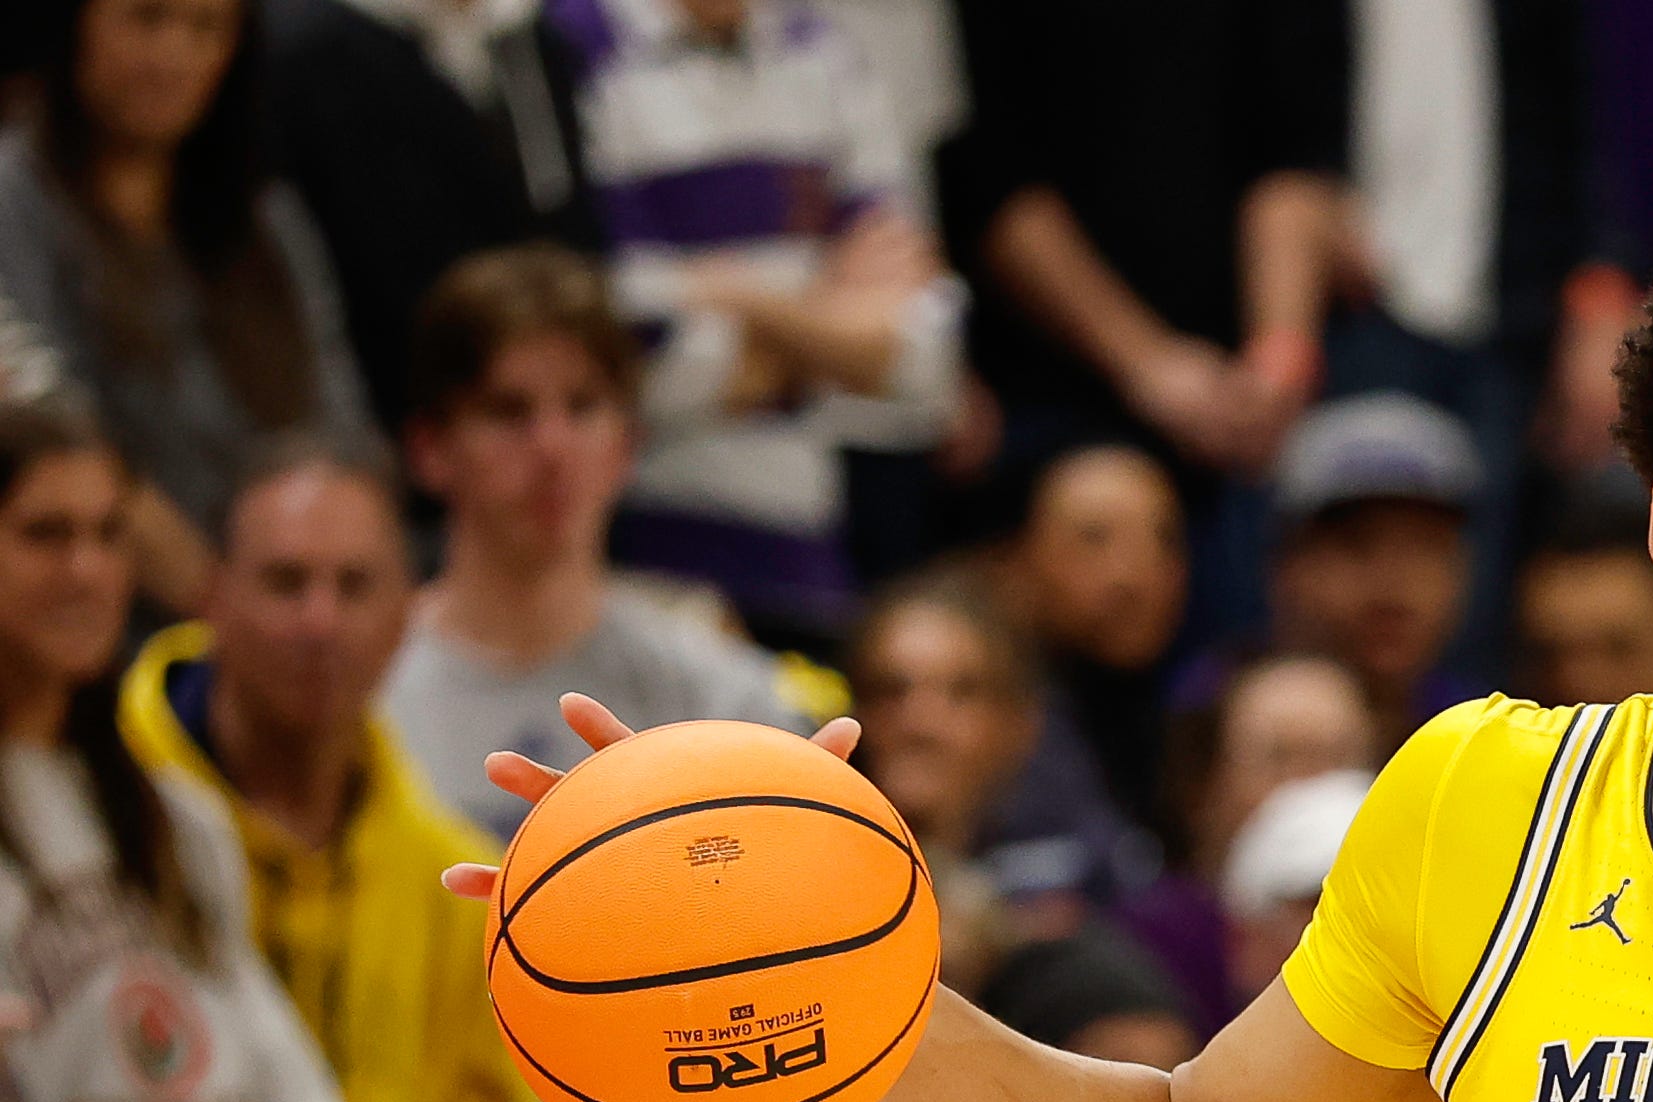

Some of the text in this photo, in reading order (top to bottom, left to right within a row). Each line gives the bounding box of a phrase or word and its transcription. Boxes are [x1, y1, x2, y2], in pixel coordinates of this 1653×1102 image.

[664, 1003, 822, 1043] OFFICIAL GAME BALL
[668, 1028, 826, 1093] PRO
